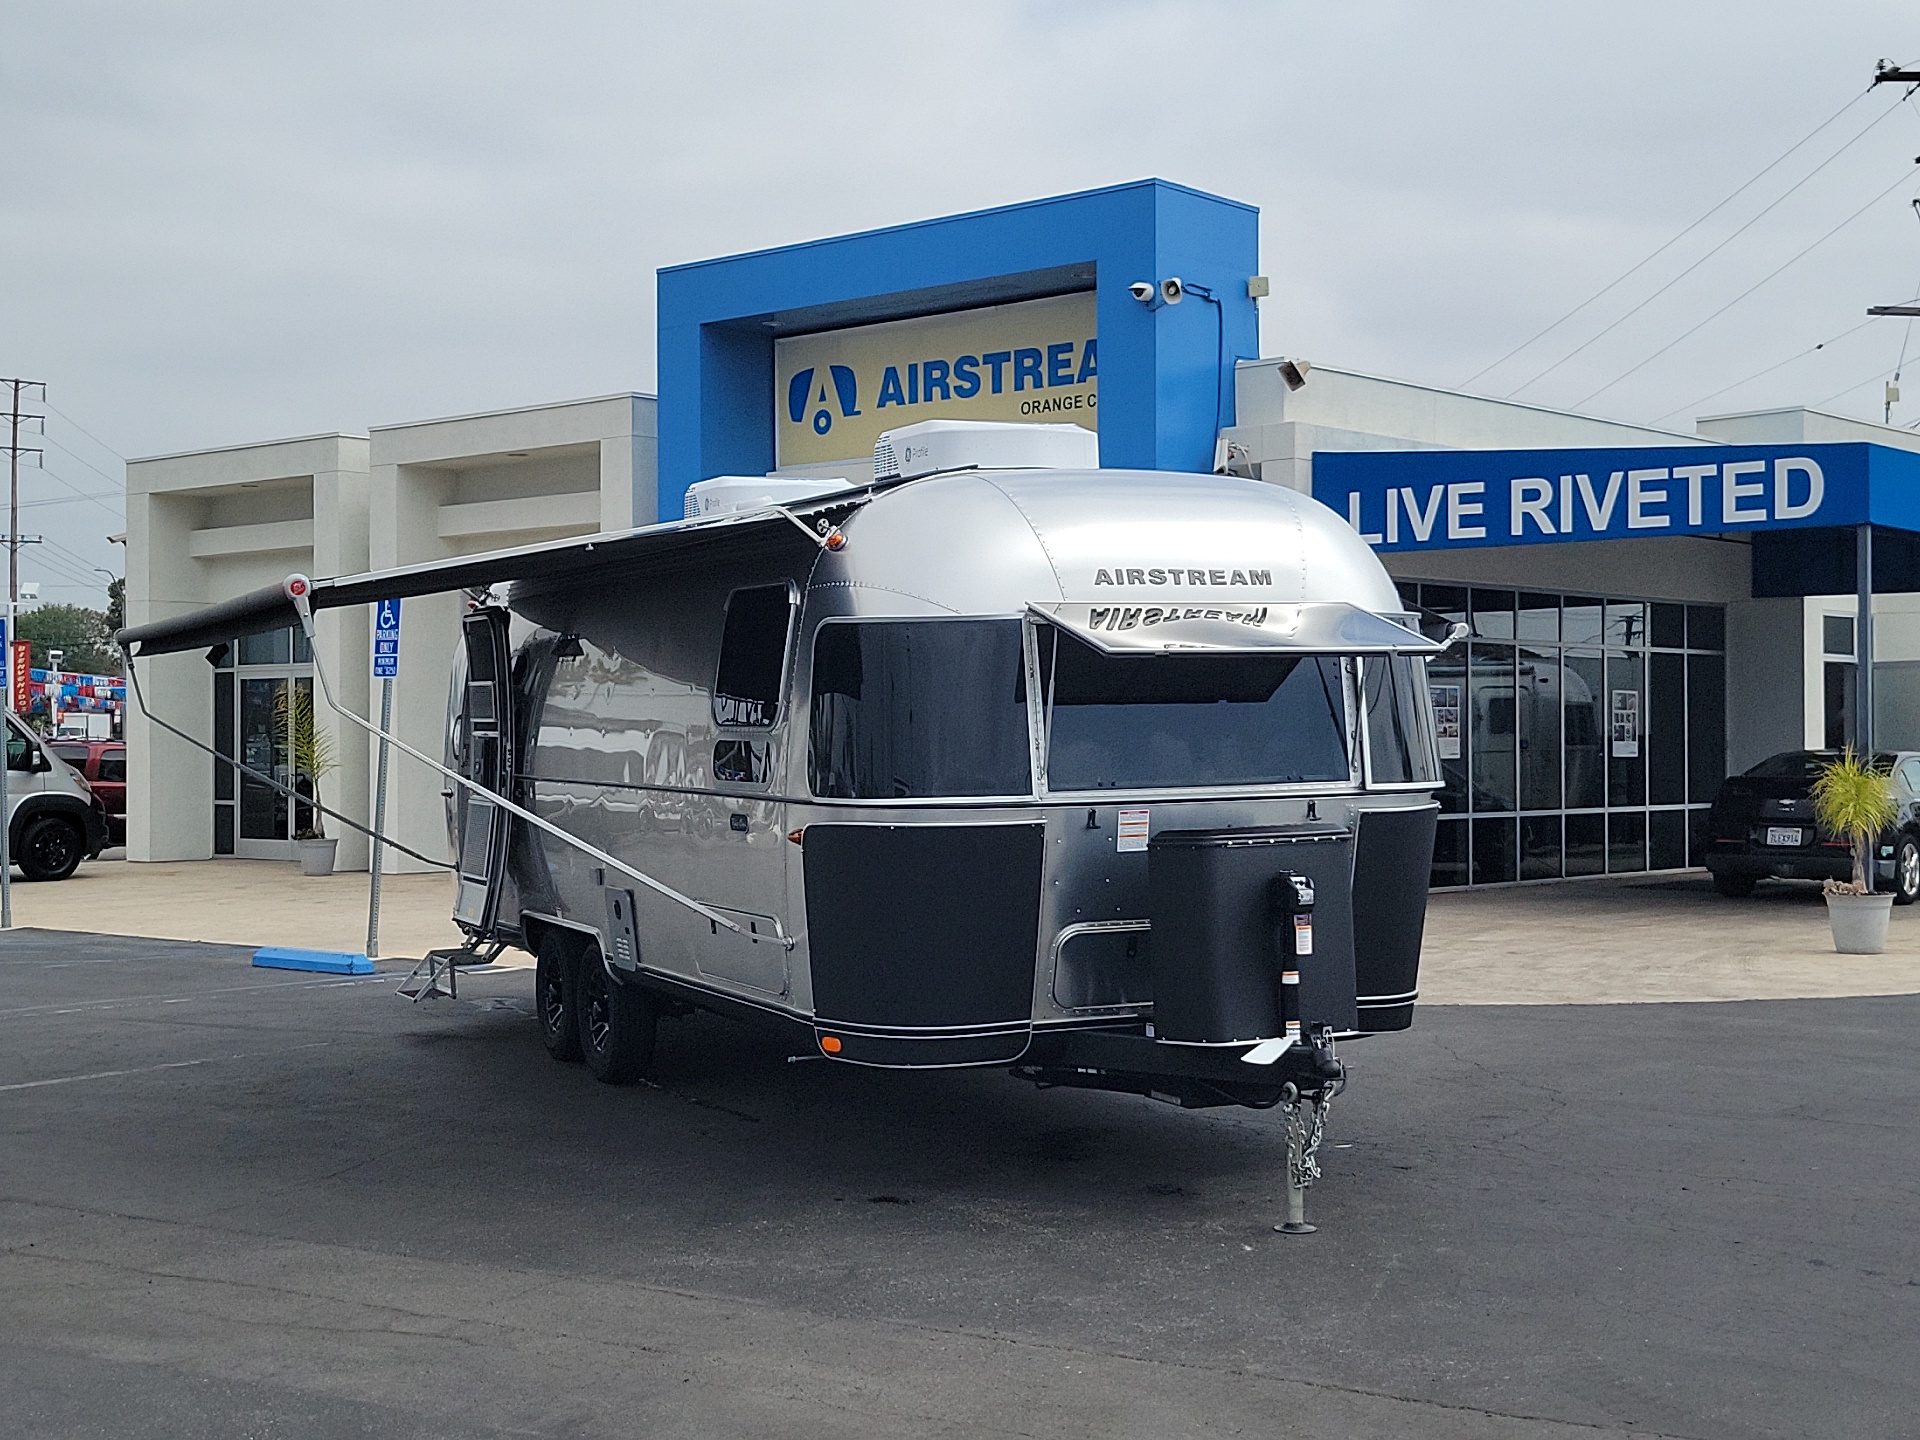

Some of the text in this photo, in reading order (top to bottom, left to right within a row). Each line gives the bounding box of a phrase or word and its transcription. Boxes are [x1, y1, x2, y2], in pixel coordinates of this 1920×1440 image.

[1020, 394, 1083, 415] ORANGE
[1348, 456, 1825, 545] LIVE RIVETED
[1094, 568, 1273, 586] AIRSTREAM
[376, 629, 398, 640] PARKING
[380, 642, 394, 653] ONLY
[17, 645, 28, 712] BIENVENIDOS
